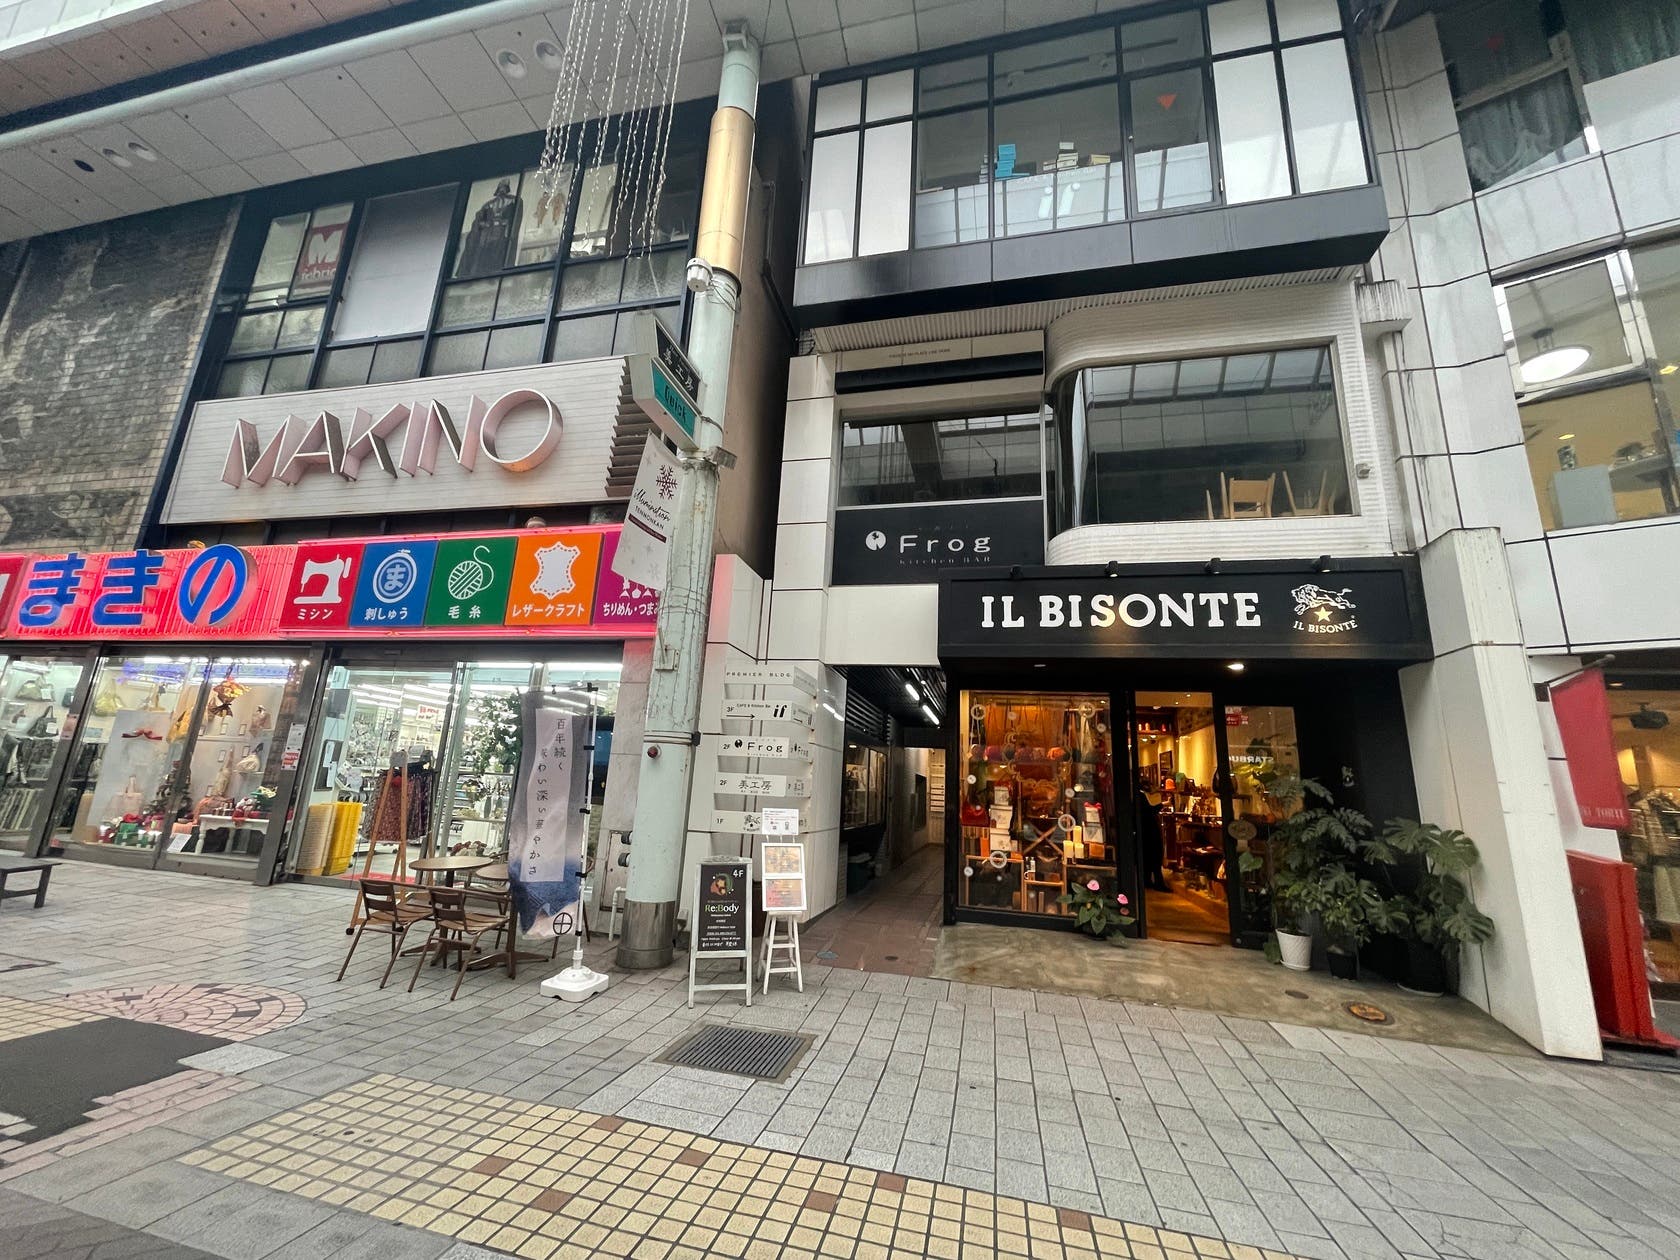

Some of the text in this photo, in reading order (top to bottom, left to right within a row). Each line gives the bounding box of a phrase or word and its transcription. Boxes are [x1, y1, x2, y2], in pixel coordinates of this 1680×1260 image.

[221, 388, 562, 488] MAKINO
[899, 534, 991, 554] Frog
[18, 543, 258, 628] まきの
[385, 565, 405, 591] ま
[297, 607, 333, 621] ミシン
[364, 606, 409, 621] 刺しゅう
[512, 603, 586, 618] レザークラフト
[980, 592, 1262, 629] IL BISONTE
[1292, 619, 1359, 635] IL BISONTE
[773, 705, 787, 718] if
[553, 718, 567, 771] 百年続く
[747, 741, 783, 753] Frog
[738, 779, 772, 791] 美工房
[732, 869, 744, 878] 4F
[704, 903, 740, 914] Re:Body
